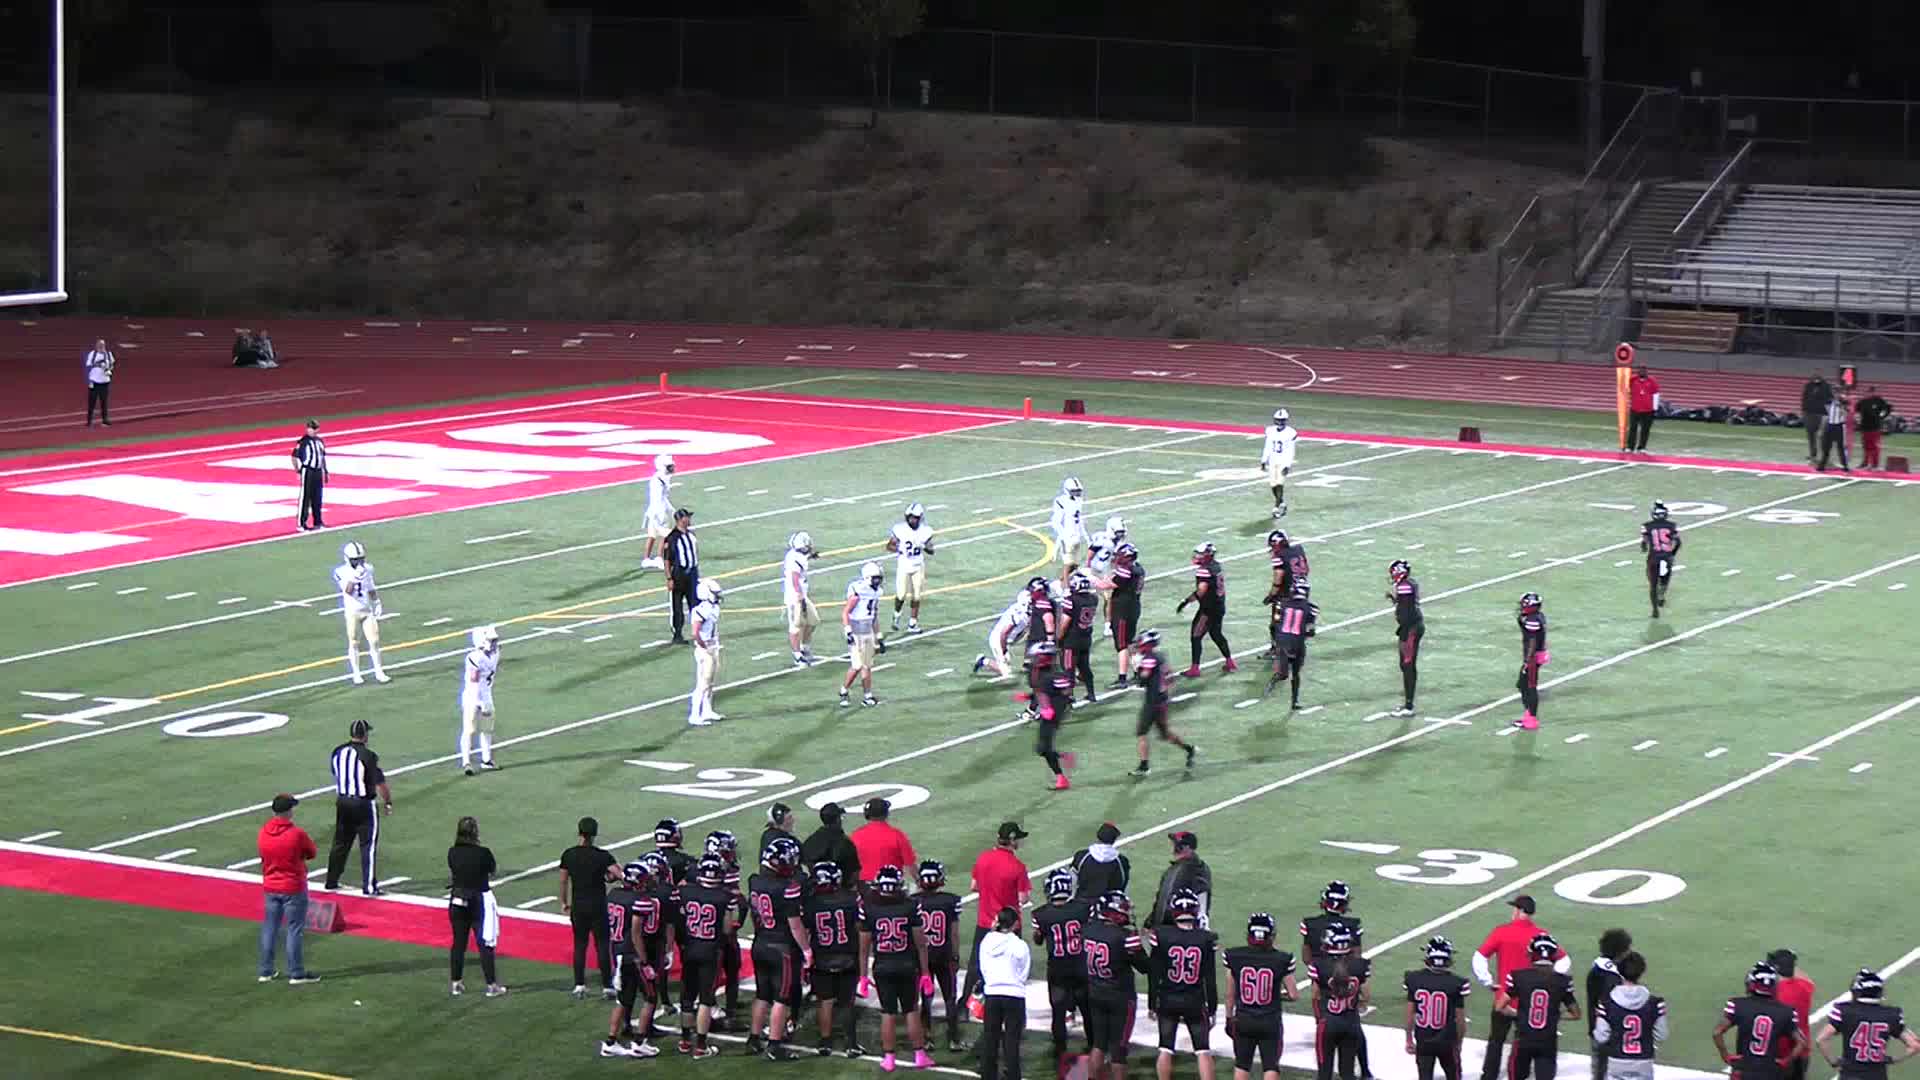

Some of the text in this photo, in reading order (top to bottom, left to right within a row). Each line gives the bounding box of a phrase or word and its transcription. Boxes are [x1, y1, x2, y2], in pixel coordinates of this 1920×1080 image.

[686, 900, 717, 939] 22
[816, 909, 848, 945] 51
[876, 917, 908, 952] 25
[1050, 919, 1082, 957] 16
[1083, 938, 1112, 978] 72
[1167, 945, 1202, 984] 33
[1240, 966, 1274, 1006] 60
[1414, 989, 1448, 1030] 30
[1528, 989, 1550, 1029] 8
[1622, 1014, 1642, 1055] 2
[1749, 1015, 1774, 1056] 9
[1849, 1021, 1890, 1063] 45
